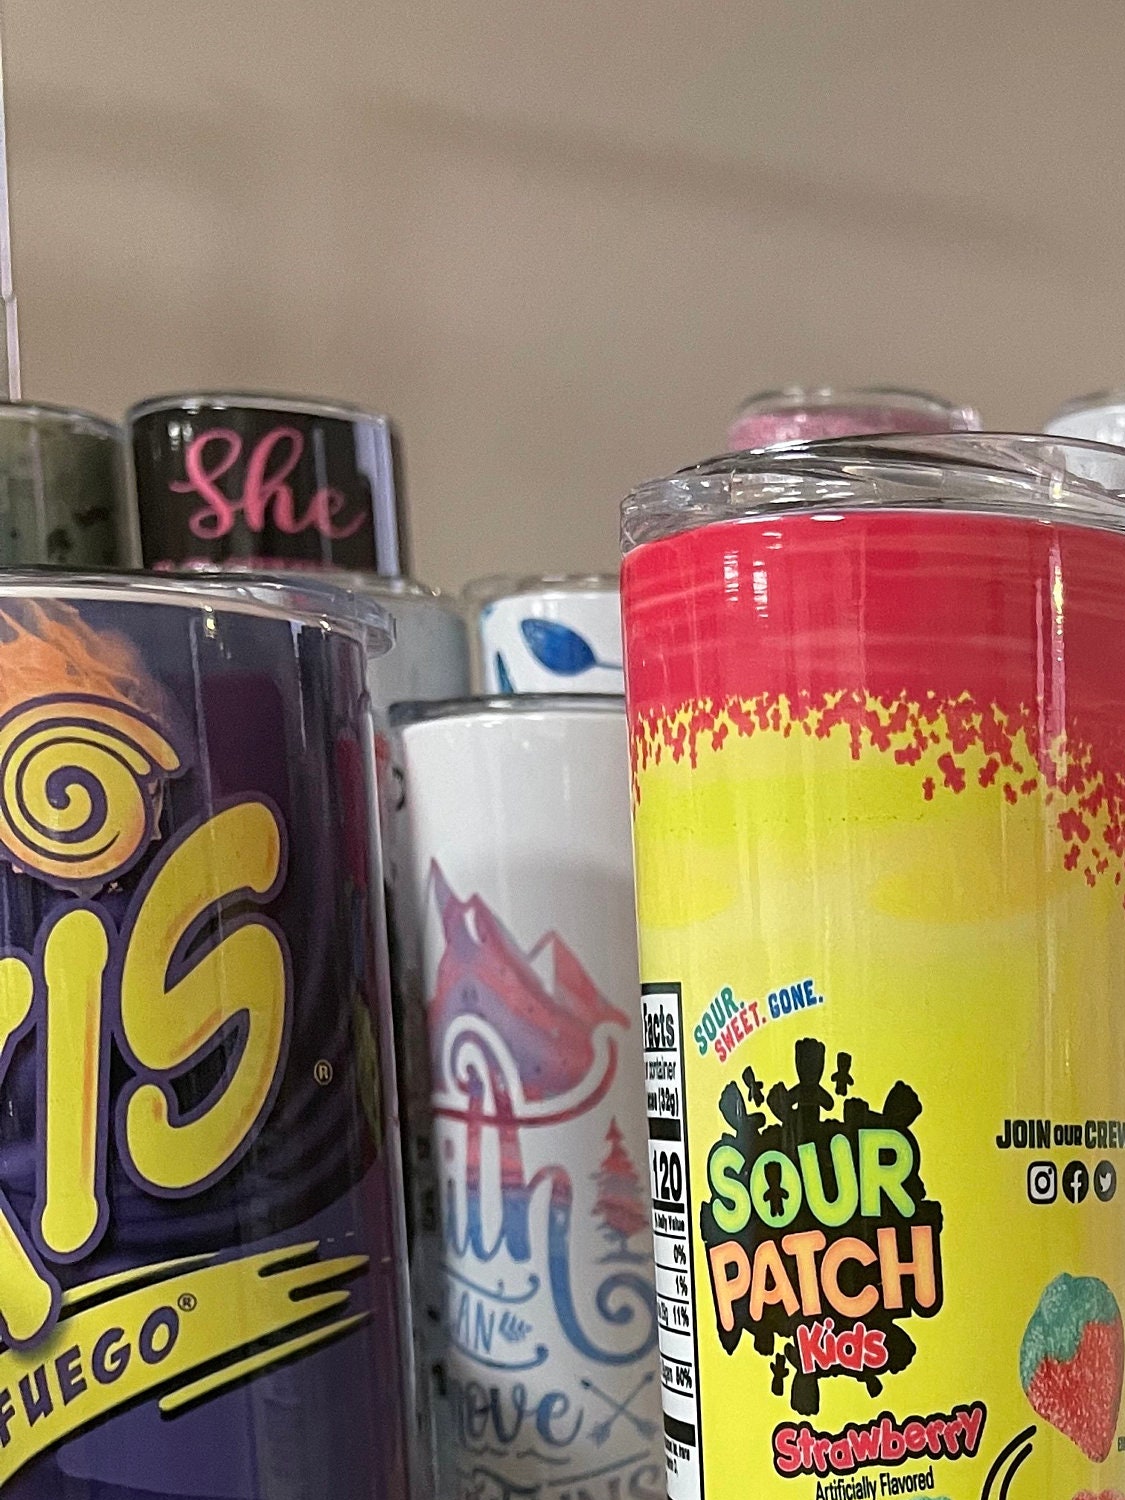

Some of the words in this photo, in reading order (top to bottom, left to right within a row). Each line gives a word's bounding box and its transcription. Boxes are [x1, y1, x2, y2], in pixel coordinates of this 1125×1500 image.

[170, 425, 366, 539] She
[694, 987, 745, 1056] SOUR.
[768, 979, 823, 1019] GONE.
[714, 1001, 767, 1063] SWEET.
[996, 1119, 1052, 1149] JOIN
[653, 1149, 682, 1202] 120
[708, 1128, 916, 1234] SOUR
[709, 1225, 937, 1332] PATCH
[796, 1317, 888, 1375] Kids
[774, 1404, 984, 1476] Strawberry
[879, 1466, 934, 1494] Flavored
